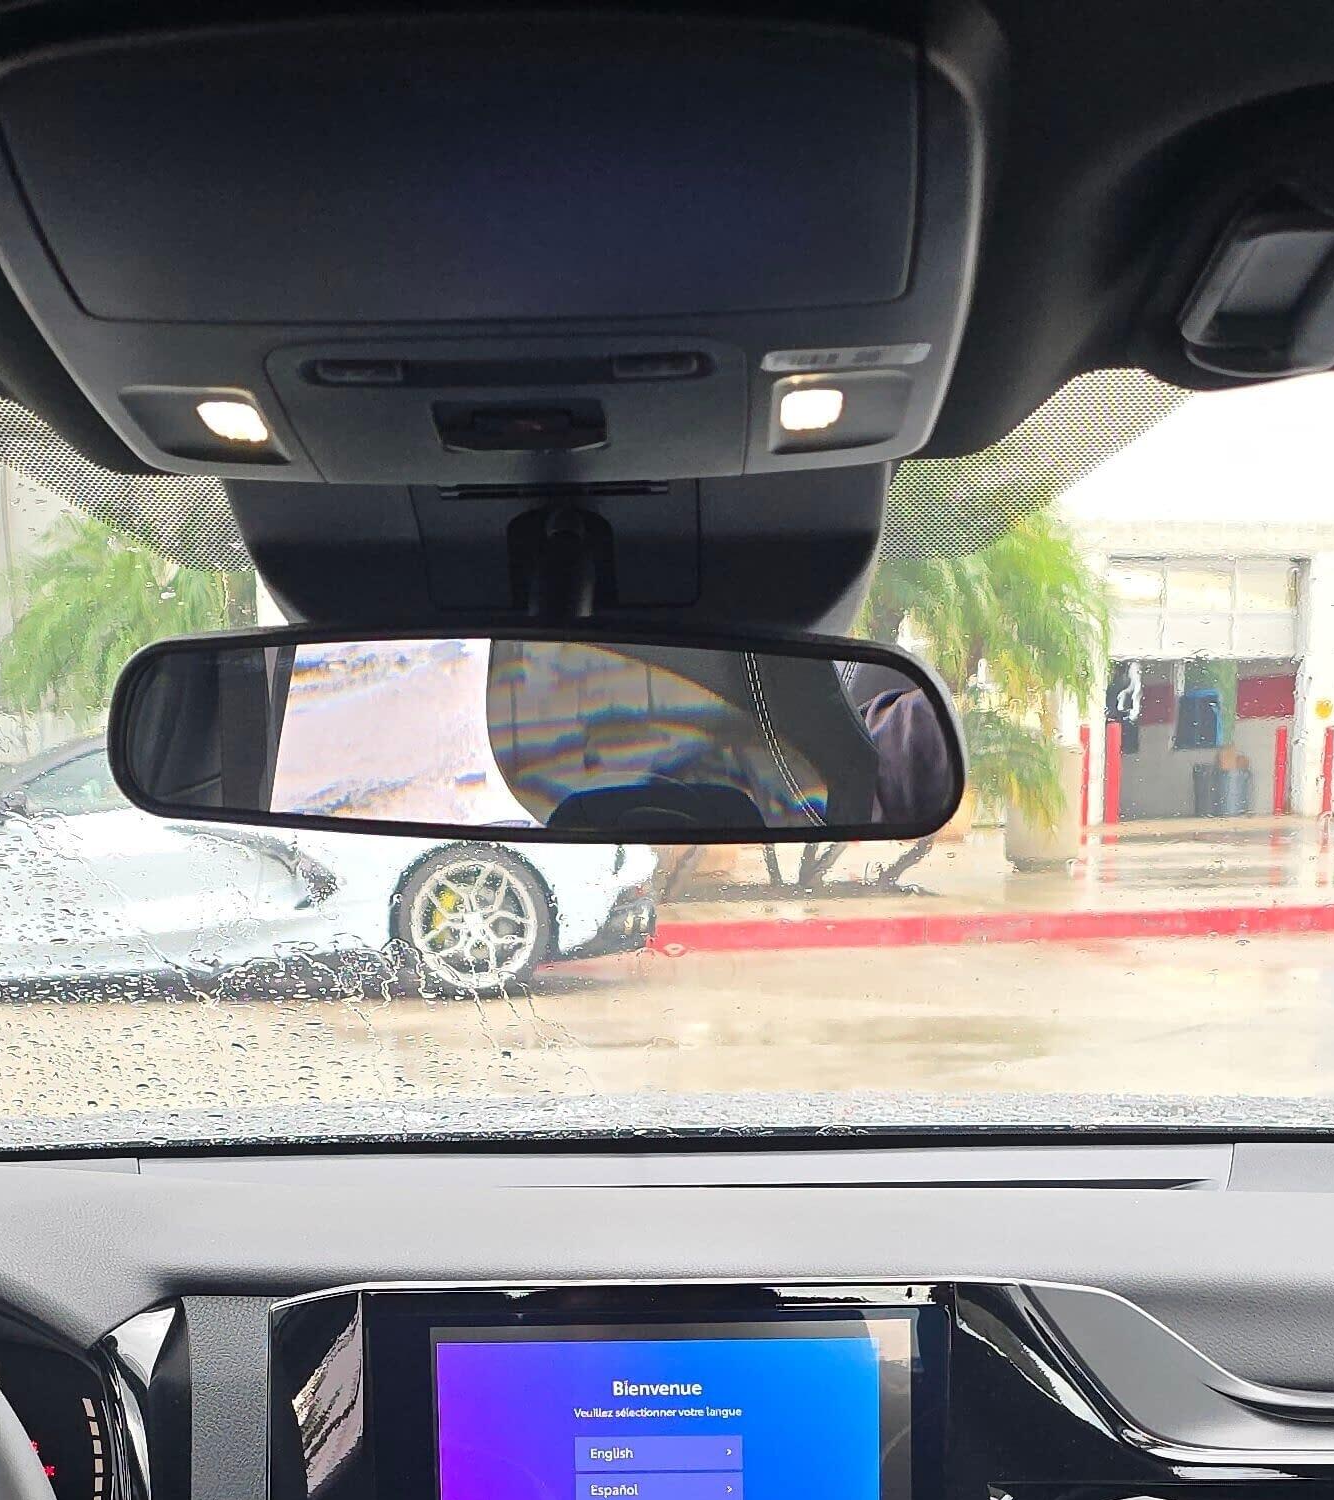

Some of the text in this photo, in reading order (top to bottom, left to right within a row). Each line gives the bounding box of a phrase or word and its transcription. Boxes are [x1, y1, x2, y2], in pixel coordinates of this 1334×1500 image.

[612, 1380, 703, 1397] Bienvenue
[574, 1407, 742, 1419] Veuillez sélectionner votre langue
[590, 1448, 634, 1462] English
[590, 1484, 639, 1498] Español
